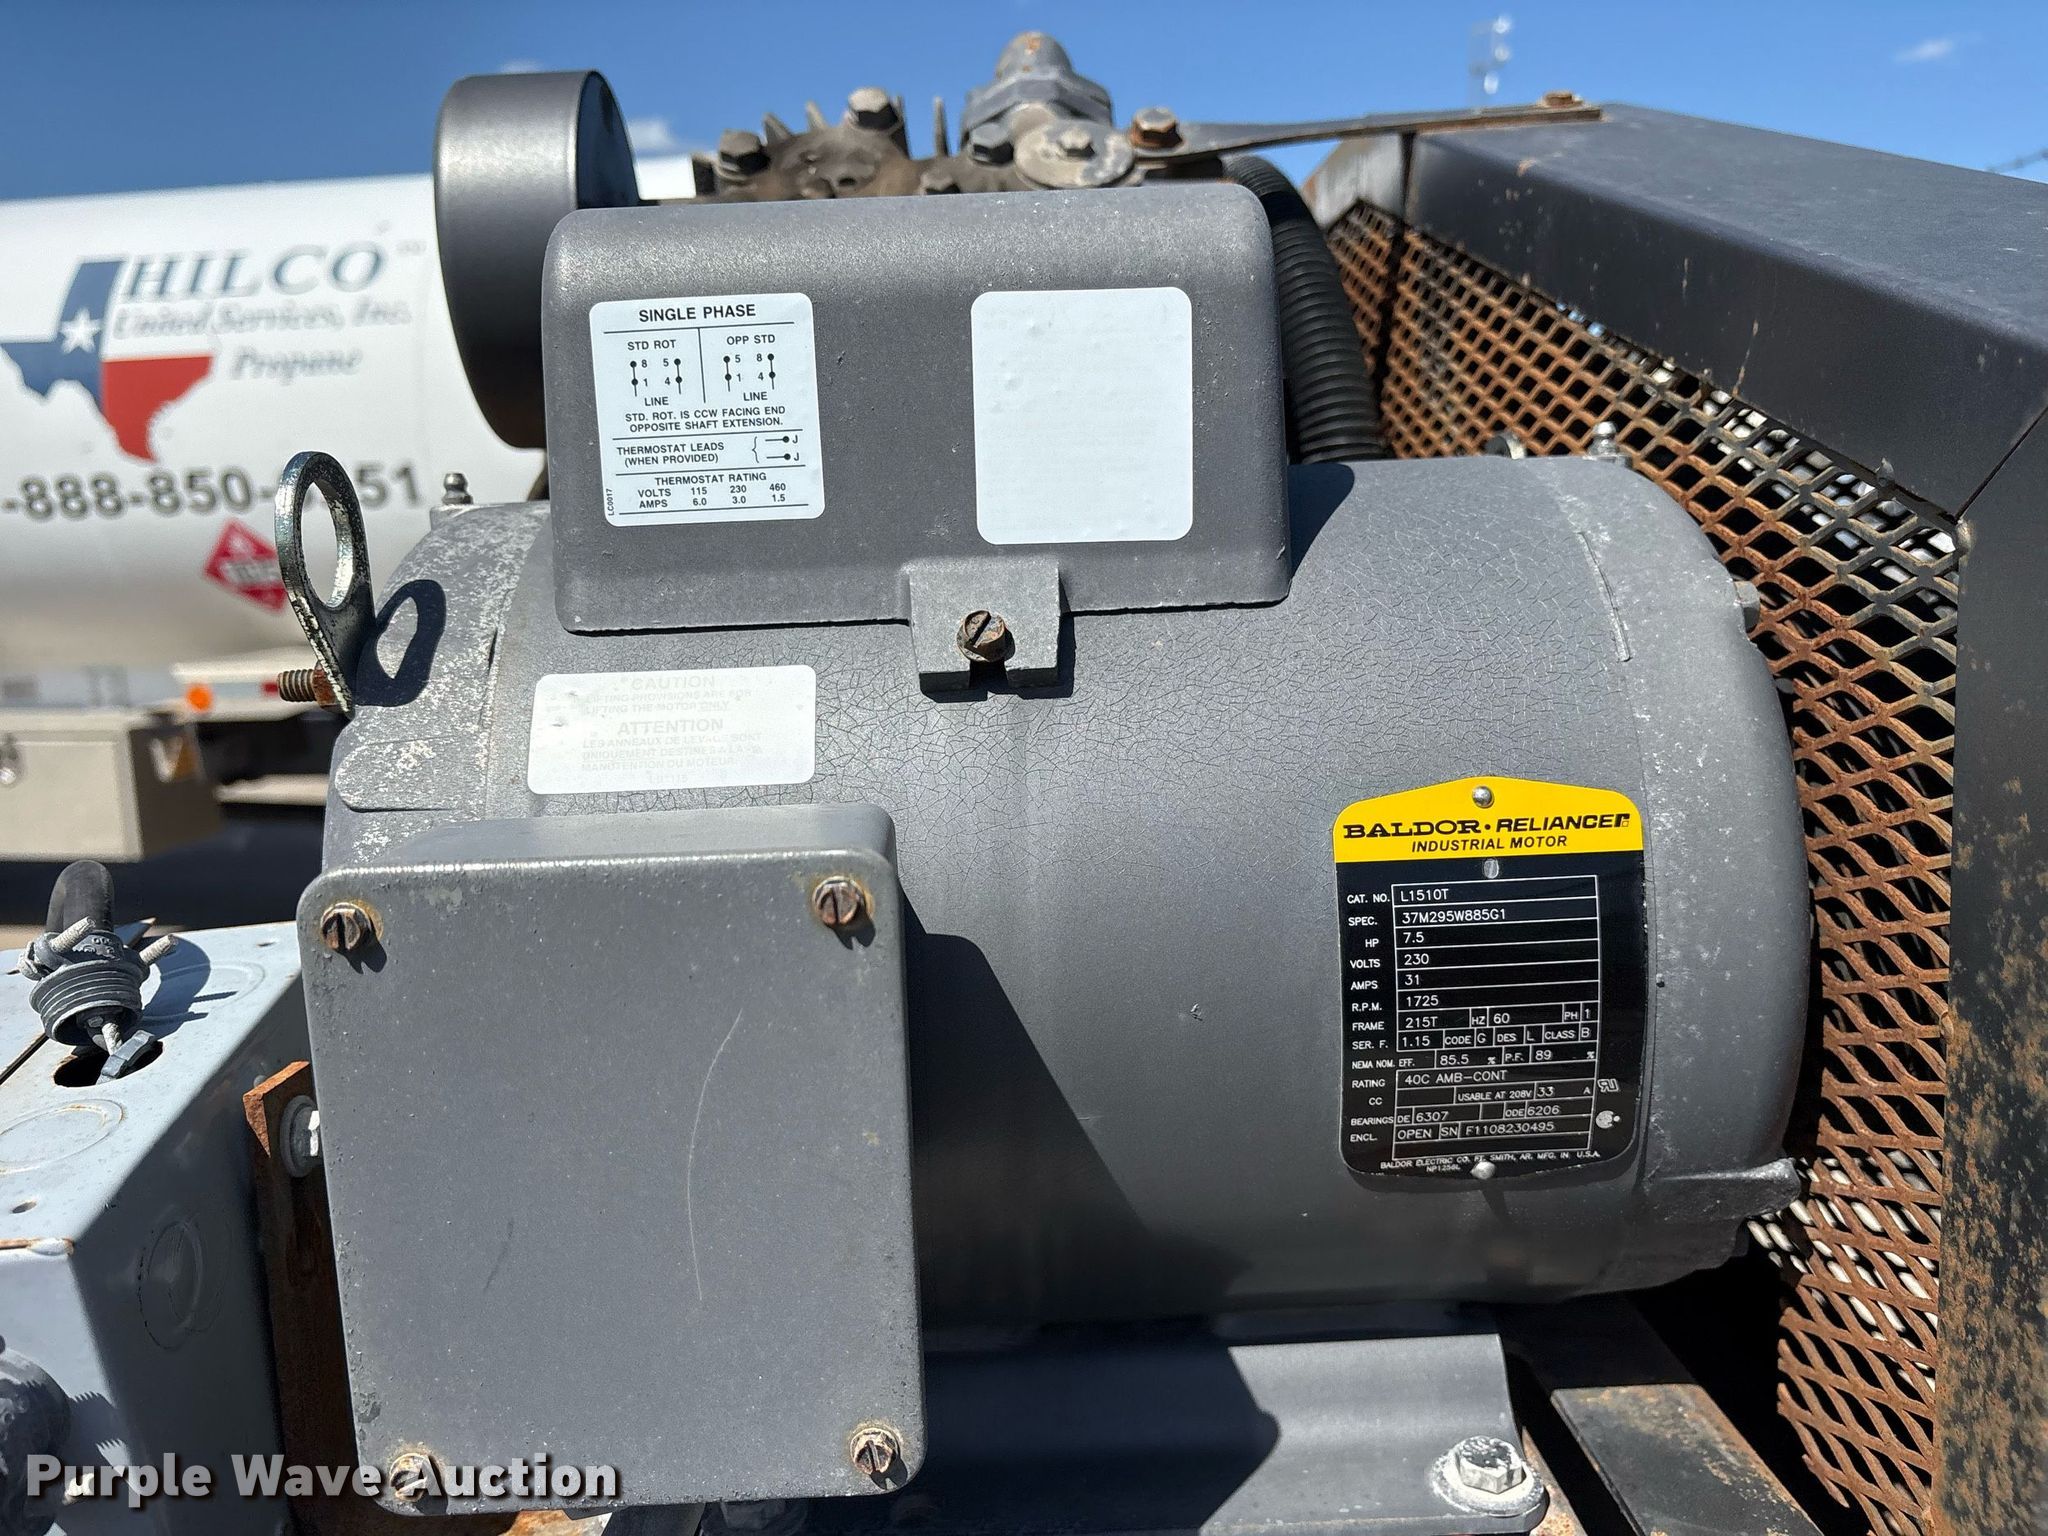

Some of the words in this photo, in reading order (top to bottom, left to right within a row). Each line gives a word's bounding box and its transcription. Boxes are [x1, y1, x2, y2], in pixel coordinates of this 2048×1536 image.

[122, 240, 385, 300] HILCO
[112, 302, 212, 339] United
[639, 307, 696, 323] SINGLE
[703, 304, 756, 319] PHASE
[627, 341, 649, 351] STD
[654, 339, 676, 349] ROT
[727, 335, 749, 345] OPP
[754, 334, 775, 344] STD
[230, 344, 363, 384] Propane
[642, 360, 647, 368] 8
[663, 358, 669, 367] 5
[735, 355, 741, 363] 5
[757, 353, 762, 362] 8
[643, 378, 648, 386] 1
[665, 377, 670, 385] 4
[737, 374, 741, 382] 1
[758, 372, 764, 381] 4
[644, 397, 669, 406] LINE
[743, 392, 767, 401] LINE
[625, 413, 648, 422] STD.
[652, 412, 676, 420] ROT.
[680, 410, 690, 419] IS
[694, 409, 718, 418] CCW
[722, 408, 760, 417] FACING
[764, 406, 785, 415] END
[630, 422, 681, 432] OPPOSITE
[685, 420, 718, 429] SHAFT
[723, 418, 783, 428] EXTENSION.
[792, 435, 798, 443] J
[617, 444, 686, 456] THERMOSTAT
[690, 442, 724, 451] LEADS
[625, 456, 659, 468] (WHEN
[663, 454, 719, 464] PROVIDED)
[794, 453, 799, 461] J
[655, 475, 724, 486] THERMOSTAT
[729, 472, 766, 482] RATING
[638, 489, 671, 498] VOLTS
[691, 487, 707, 495] 115
[730, 485, 747, 493] 230
[769, 483, 786, 491] 460
[639, 500, 668, 508] AMPS
[693, 498, 707, 506] 6.0
[732, 496, 746, 504] 3.0
[772, 494, 785, 502] 1.5
[631, 675, 715, 690] CAUTION
[632, 692, 700, 702] PROVISIONS
[585, 704, 628, 714] LIFTING
[632, 703, 653, 712] THE
[700, 701, 729, 712] ONLY
[617, 719, 723, 736] ATTENTION
[1343, 820, 1480, 839] BALDOR
[1496, 814, 1615, 833] RELIANCE
[1412, 838, 1505, 853] INDUSTRIAL
[1510, 835, 1567, 849] MOTOR
[1347, 894, 1368, 904] CAT.
[1373, 893, 1390, 903] NO.
[1400, 889, 1449, 901] L1510T
[1348, 916, 1377, 926] SPEC.
[1402, 909, 1506, 924] 37M295W885G1
[1365, 938, 1379, 948] HP
[1403, 932, 1424, 943] 7.5
[1350, 959, 1380, 968] VOLTS
[1404, 953, 1429, 965] 230
[1351, 980, 1378, 990] AMPS
[1404, 975, 1420, 986] 31
[1352, 1002, 1382, 1012] R.P.M.
[1406, 995, 1439, 1007] 1725
[1352, 1022, 1384, 1031] FRAME
[1405, 1017, 1438, 1028] 215T
[1472, 1016, 1486, 1025] HZ
[1493, 1013, 1510, 1024] 60
[1564, 1011, 1578, 1020] PH
[1584, 1009, 1591, 1019] 1
[1352, 1041, 1374, 1050] SER.
[1380, 1040, 1388, 1048] F.
[1402, 1035, 1430, 1047] 1.15
[1445, 1035, 1471, 1045] CODE
[1477, 1033, 1486, 1043] G
[1497, 1033, 1516, 1042] DES
[1527, 1031, 1534, 1041] L
[1545, 1030, 1575, 1039] CLASS
[1581, 1028, 1590, 1038] B
[1352, 1061, 1374, 1069] NEMA
[1376, 1060, 1395, 1068] NOM.
[1399, 1058, 1415, 1067] EFF.
[1440, 1055, 1469, 1065] 85.5
[1505, 1053, 1524, 1062] P.F.
[1535, 1050, 1551, 1060] 89
[1352, 1079, 1385, 1088] RATING
[1405, 1074, 1430, 1085] 40C
[1436, 1070, 1507, 1083] AMB-CONT
[1369, 1097, 1383, 1105] CC
[1458, 1092, 1492, 1101] USABLE
[1495, 1091, 1506, 1099] AT
[1509, 1090, 1532, 1098] 208V
[1537, 1087, 1554, 1097] 33
[1351, 1116, 1393, 1126] BEARINGS
[1397, 1115, 1410, 1123] DE
[1416, 1111, 1448, 1122] 6307
[1505, 1109, 1524, 1117] ODE
[1527, 1105, 1560, 1116] 6206
[1350, 1134, 1377, 1142] ENCL.
[1398, 1129, 1431, 1139] OPEN
[1441, 1127, 1458, 1136] SN
[1466, 1122, 1555, 1135] F1108230495
[1381, 1160, 1412, 1169] BALDOR
[1416, 1157, 1453, 1166] ELECTRIC
